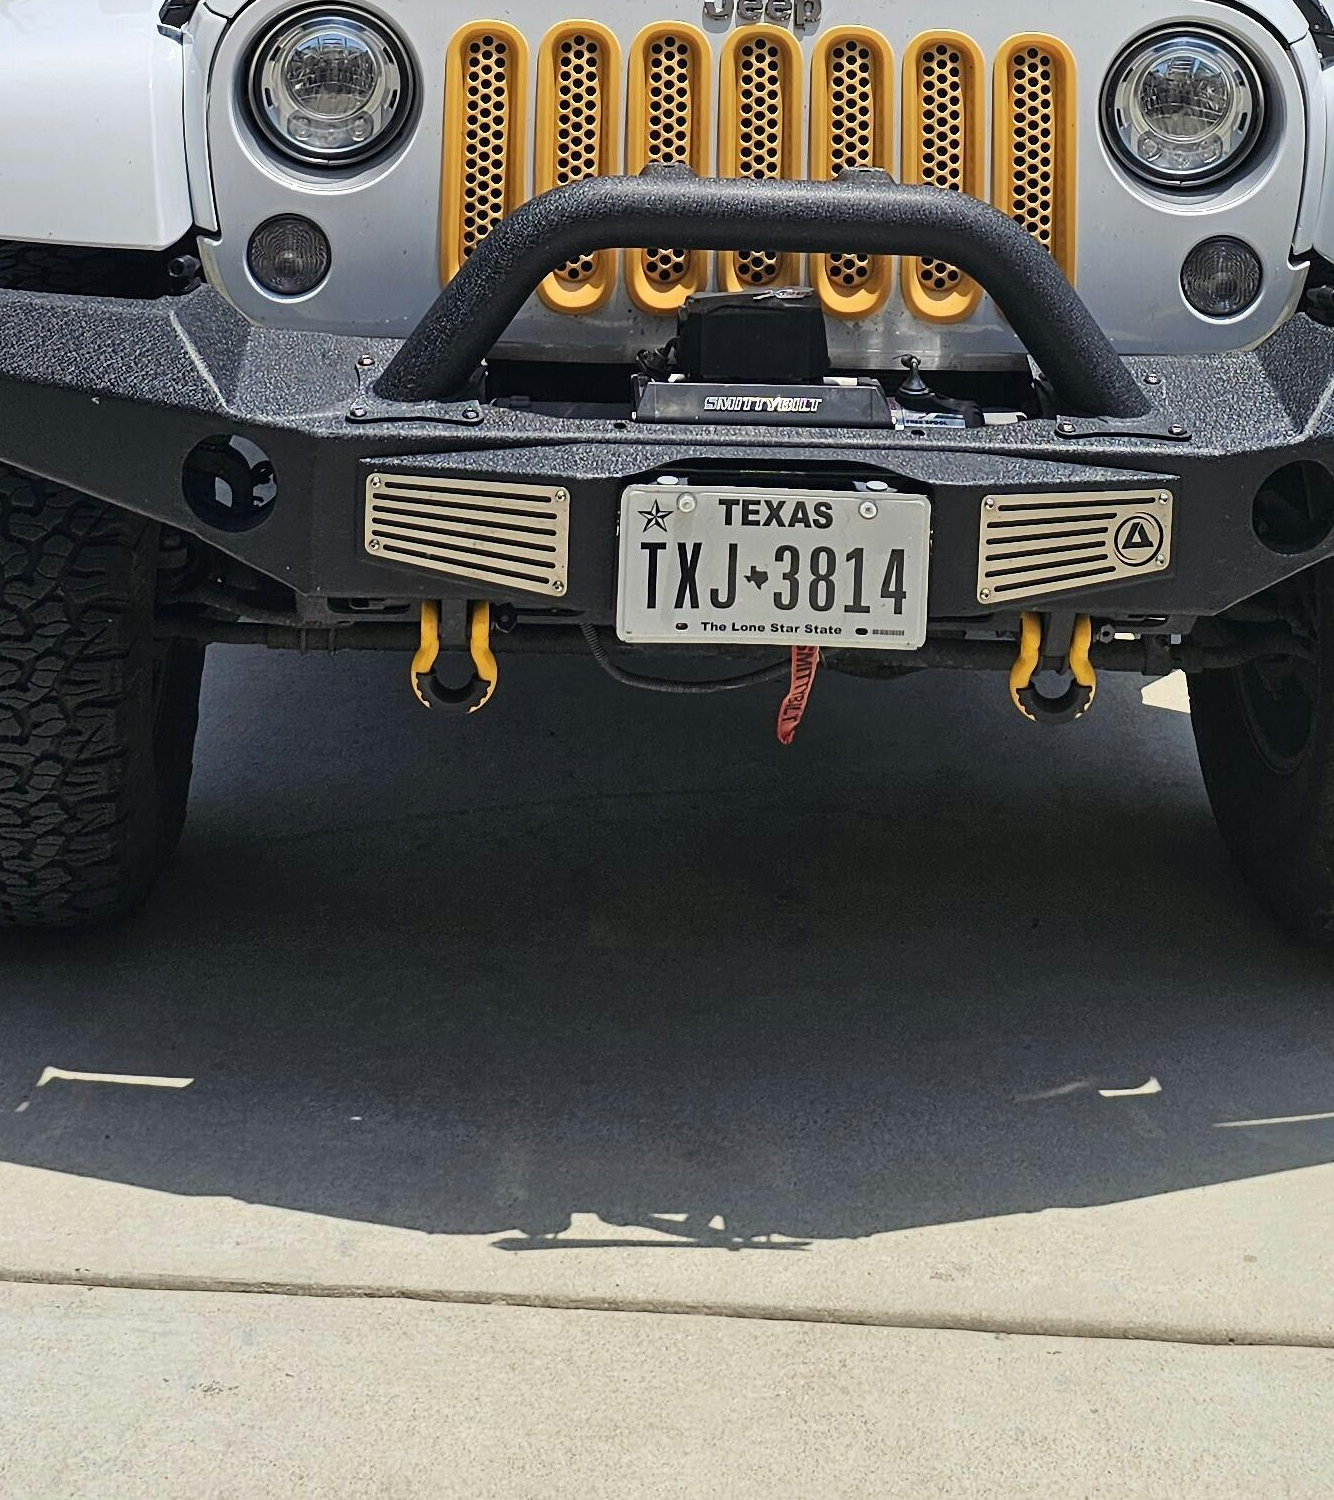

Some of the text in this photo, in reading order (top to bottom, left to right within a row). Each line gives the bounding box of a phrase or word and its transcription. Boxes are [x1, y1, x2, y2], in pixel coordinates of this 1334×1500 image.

[703, 396, 822, 413] SMITTYBILT
[718, 498, 833, 529] TEXAS
[701, 621, 842, 635] The Lone Star State
